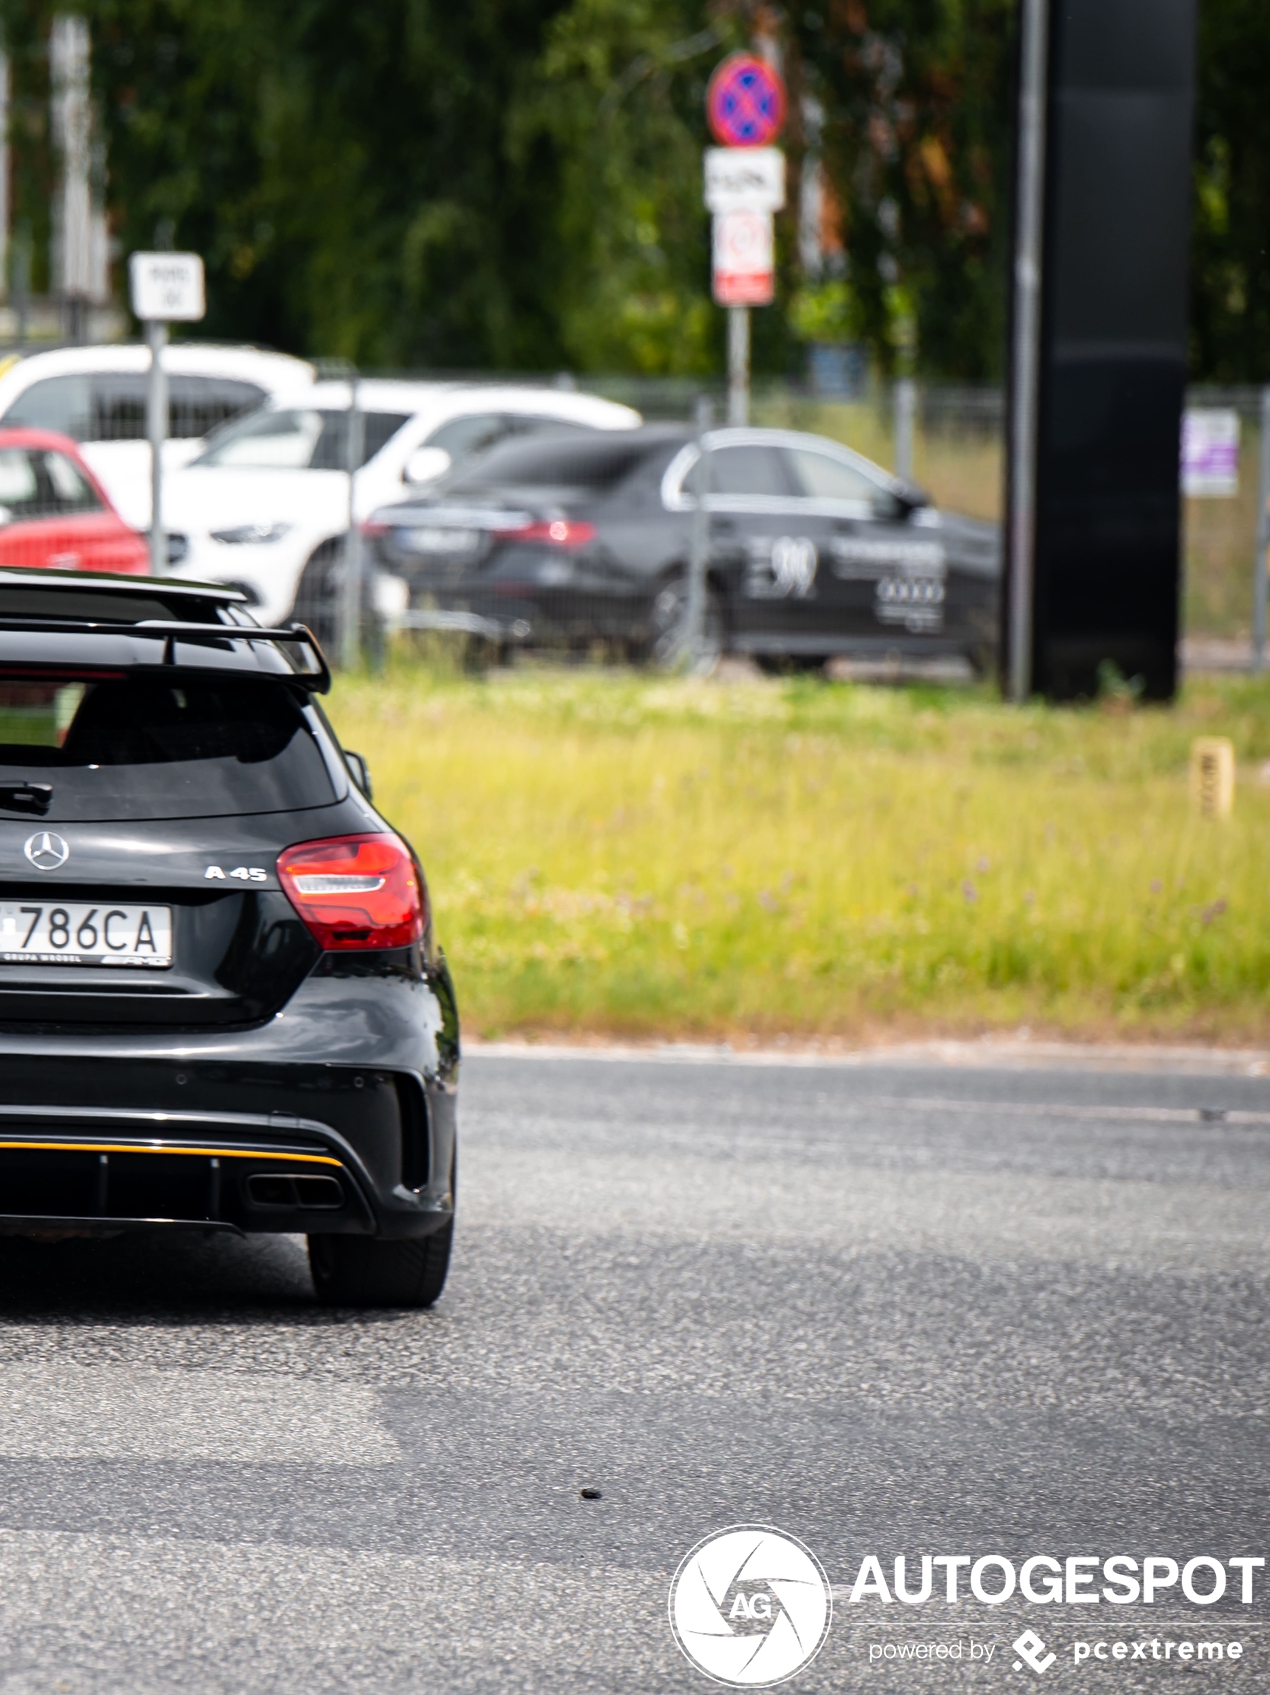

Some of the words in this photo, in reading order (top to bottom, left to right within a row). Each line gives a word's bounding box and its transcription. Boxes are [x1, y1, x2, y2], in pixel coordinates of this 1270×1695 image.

[204, 865, 227, 879] A
[229, 866, 268, 882] 45
[19, 907, 158, 953] 786CA
[3, 953, 38, 961] GRUPA
